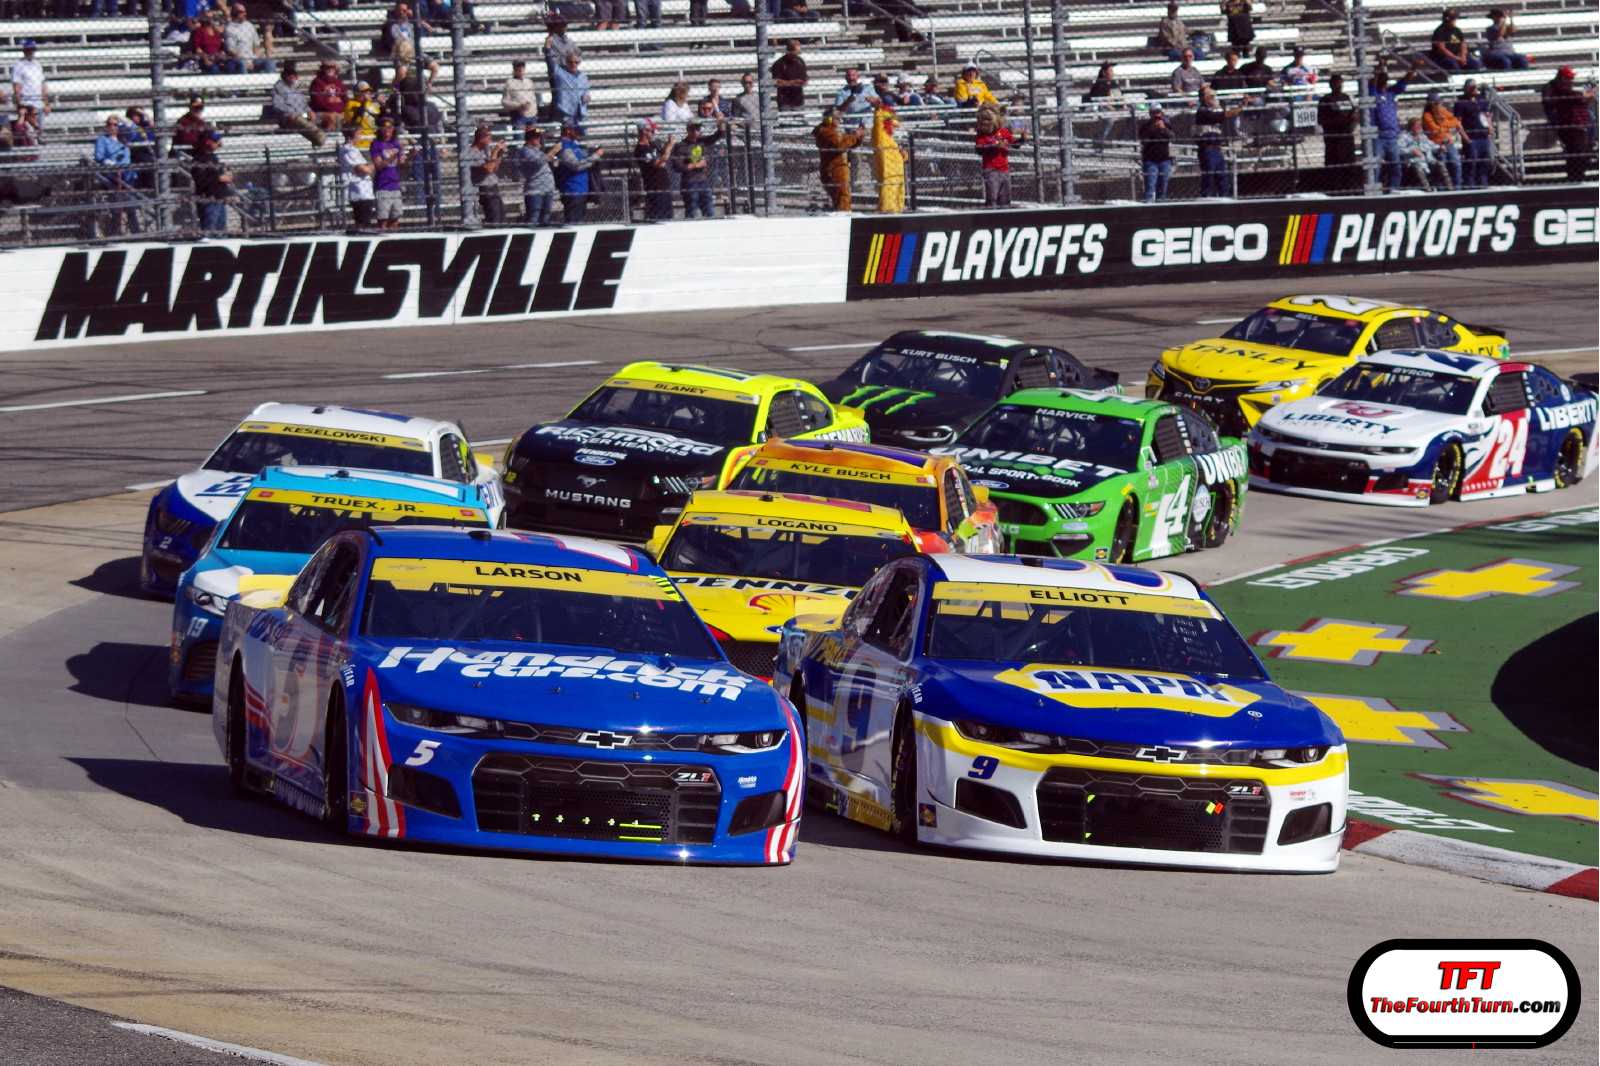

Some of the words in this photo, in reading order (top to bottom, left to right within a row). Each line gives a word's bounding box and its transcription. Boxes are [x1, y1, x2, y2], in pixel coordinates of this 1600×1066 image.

[1131, 223, 1268, 267] GEICO
[1332, 205, 1519, 263] PLAYOFFS
[917, 224, 1108, 283] PLAYOFFS
[35, 229, 635, 341] MARTINSVILLE
[901, 348, 935, 357] KURT
[935, 353, 977, 363] BUSCH
[1167, 344, 1319, 371] STANLEY
[1392, 367, 1435, 378] BYRON
[654, 383, 709, 395] BLANEY
[1174, 391, 1225, 404] CAMRY
[1036, 407, 1097, 421] HARVICK
[1282, 413, 1401, 435] LIBERTY
[282, 425, 387, 443] KESELOWSKI
[557, 434, 612, 445] WATER
[615, 439, 688, 456] HEATERS
[1488, 417, 1530, 480] 24
[790, 463, 831, 474] KYLE
[836, 469, 891, 480] BUSCH
[928, 446, 1129, 478] UNIBET
[392, 501, 425, 513] JR.
[545, 489, 632, 508] MUSTANG
[1165, 474, 1191, 537] 4
[756, 518, 838, 532] LOGANO
[159, 537, 172, 549] 2
[475, 565, 583, 583] LARSON
[1030, 589, 1129, 605] ELLIOTT
[186, 616, 209, 638] 19
[378, 647, 753, 690] Hendrick
[460, 663, 743, 701] cars.com
[1034, 670, 1230, 702] NAPA
[404, 739, 442, 767] 5
[967, 755, 1000, 780] 9
